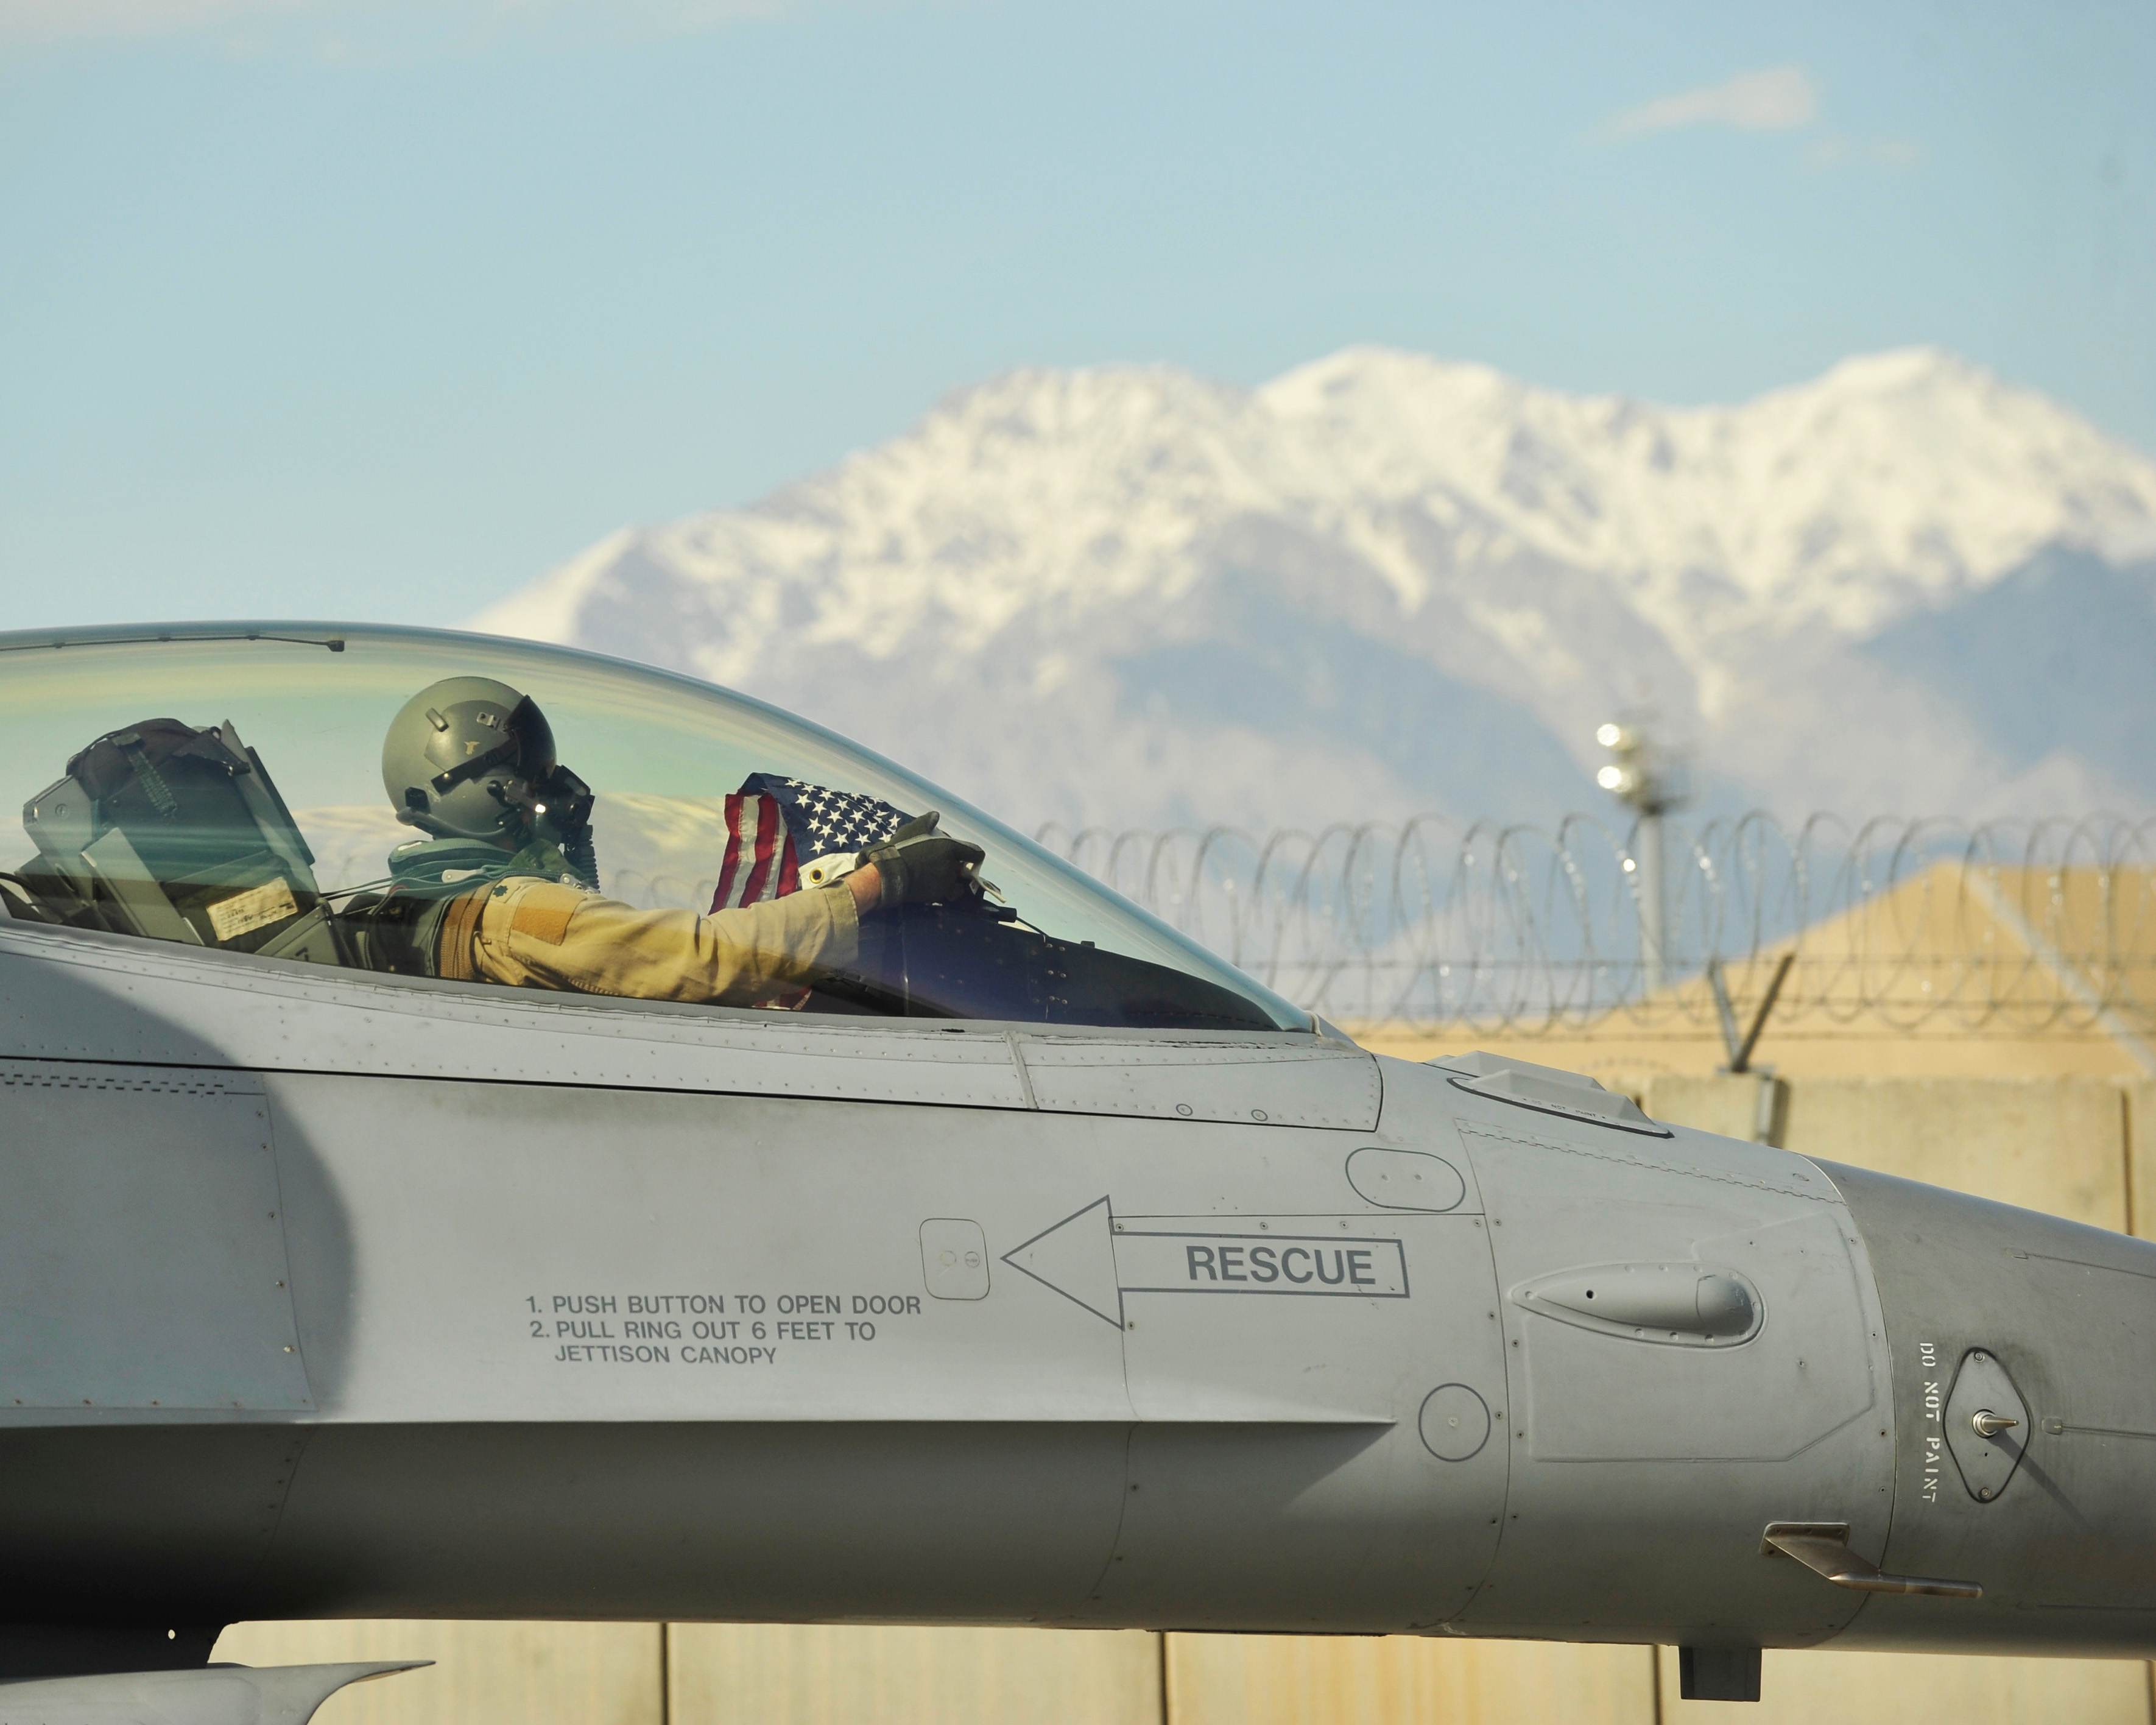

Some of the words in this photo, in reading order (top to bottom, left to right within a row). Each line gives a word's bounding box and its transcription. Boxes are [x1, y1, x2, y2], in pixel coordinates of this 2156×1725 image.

[1186, 1245, 1376, 1285] RESCUE
[526, 1296, 542, 1313] 1.
[552, 1296, 617, 1314] PUSH
[627, 1295, 725, 1314] BUTTON
[734, 1295, 766, 1314] TO
[777, 1295, 842, 1314] OPEN
[852, 1295, 921, 1314] DOOR
[529, 1321, 549, 1338] 2.
[555, 1321, 615, 1338] PULL
[624, 1321, 682, 1339] RING
[692, 1321, 741, 1339] OUT
[751, 1321, 766, 1340] 6
[777, 1322, 835, 1341] FEET
[844, 1322, 876, 1341] TO
[554, 1345, 671, 1363] JETTISON
[680, 1346, 777, 1364] CANOPY
[1920, 1342, 1936, 1367] DO
[1923, 1381, 1940, 1422] NOT
[1922, 1437, 1940, 1503] PAINT
